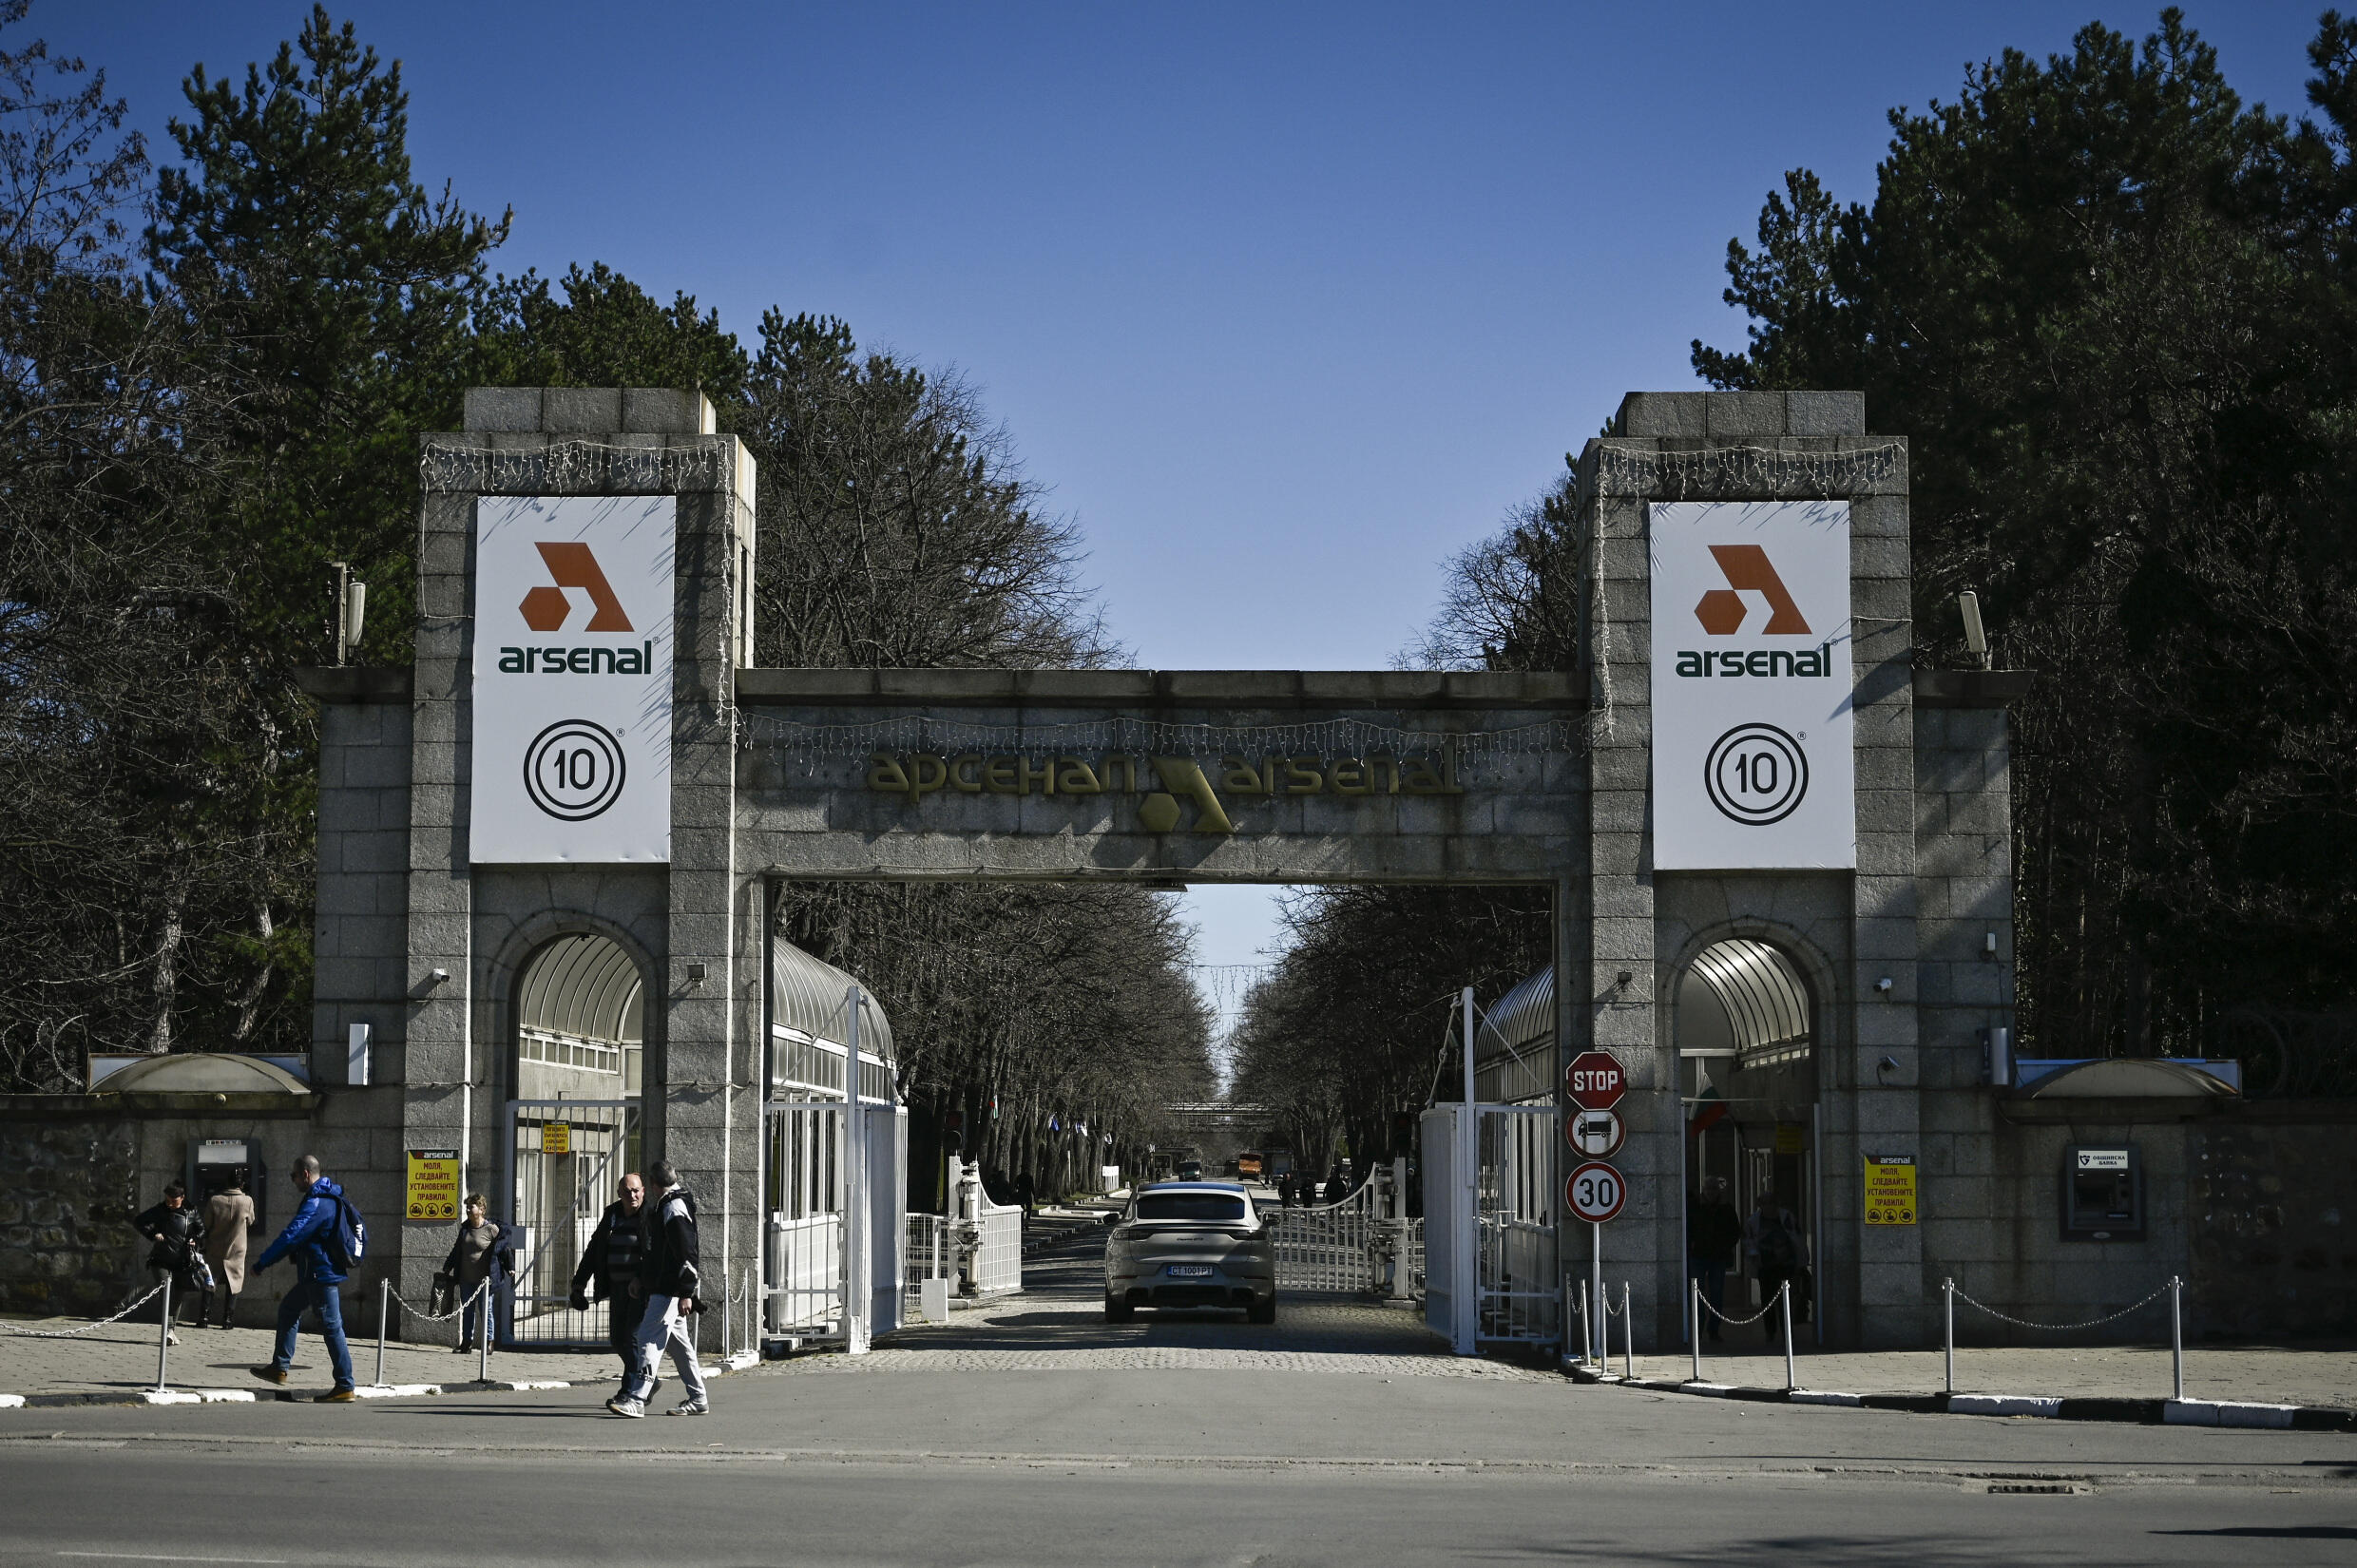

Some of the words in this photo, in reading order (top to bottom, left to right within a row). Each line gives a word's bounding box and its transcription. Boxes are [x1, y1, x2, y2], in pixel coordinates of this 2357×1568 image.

[498, 640, 652, 675] arsenal
[1676, 642, 1831, 678] arsenal
[553, 748, 595, 791] 10
[1220, 741, 1465, 794] arsenal
[1734, 752, 1777, 794] 10
[1574, 1070, 1619, 1092] STOP
[423, 1162, 443, 1171] МОЛЯ,
[414, 1172, 450, 1181] СЛЕДВАЙТЕ
[1872, 1177, 1908, 1186] СЛЕДВАЙТЕ
[410, 1182, 455, 1191] УСТАНОВЕНИТЕ
[1579, 1177, 1614, 1208] 30
[1867, 1188, 1913, 1196] УСТАНОВЕНИТЕ
[417, 1193, 448, 1201] ПРАВИЛА!
[1874, 1198, 1906, 1207] ПРАВИЛА!
